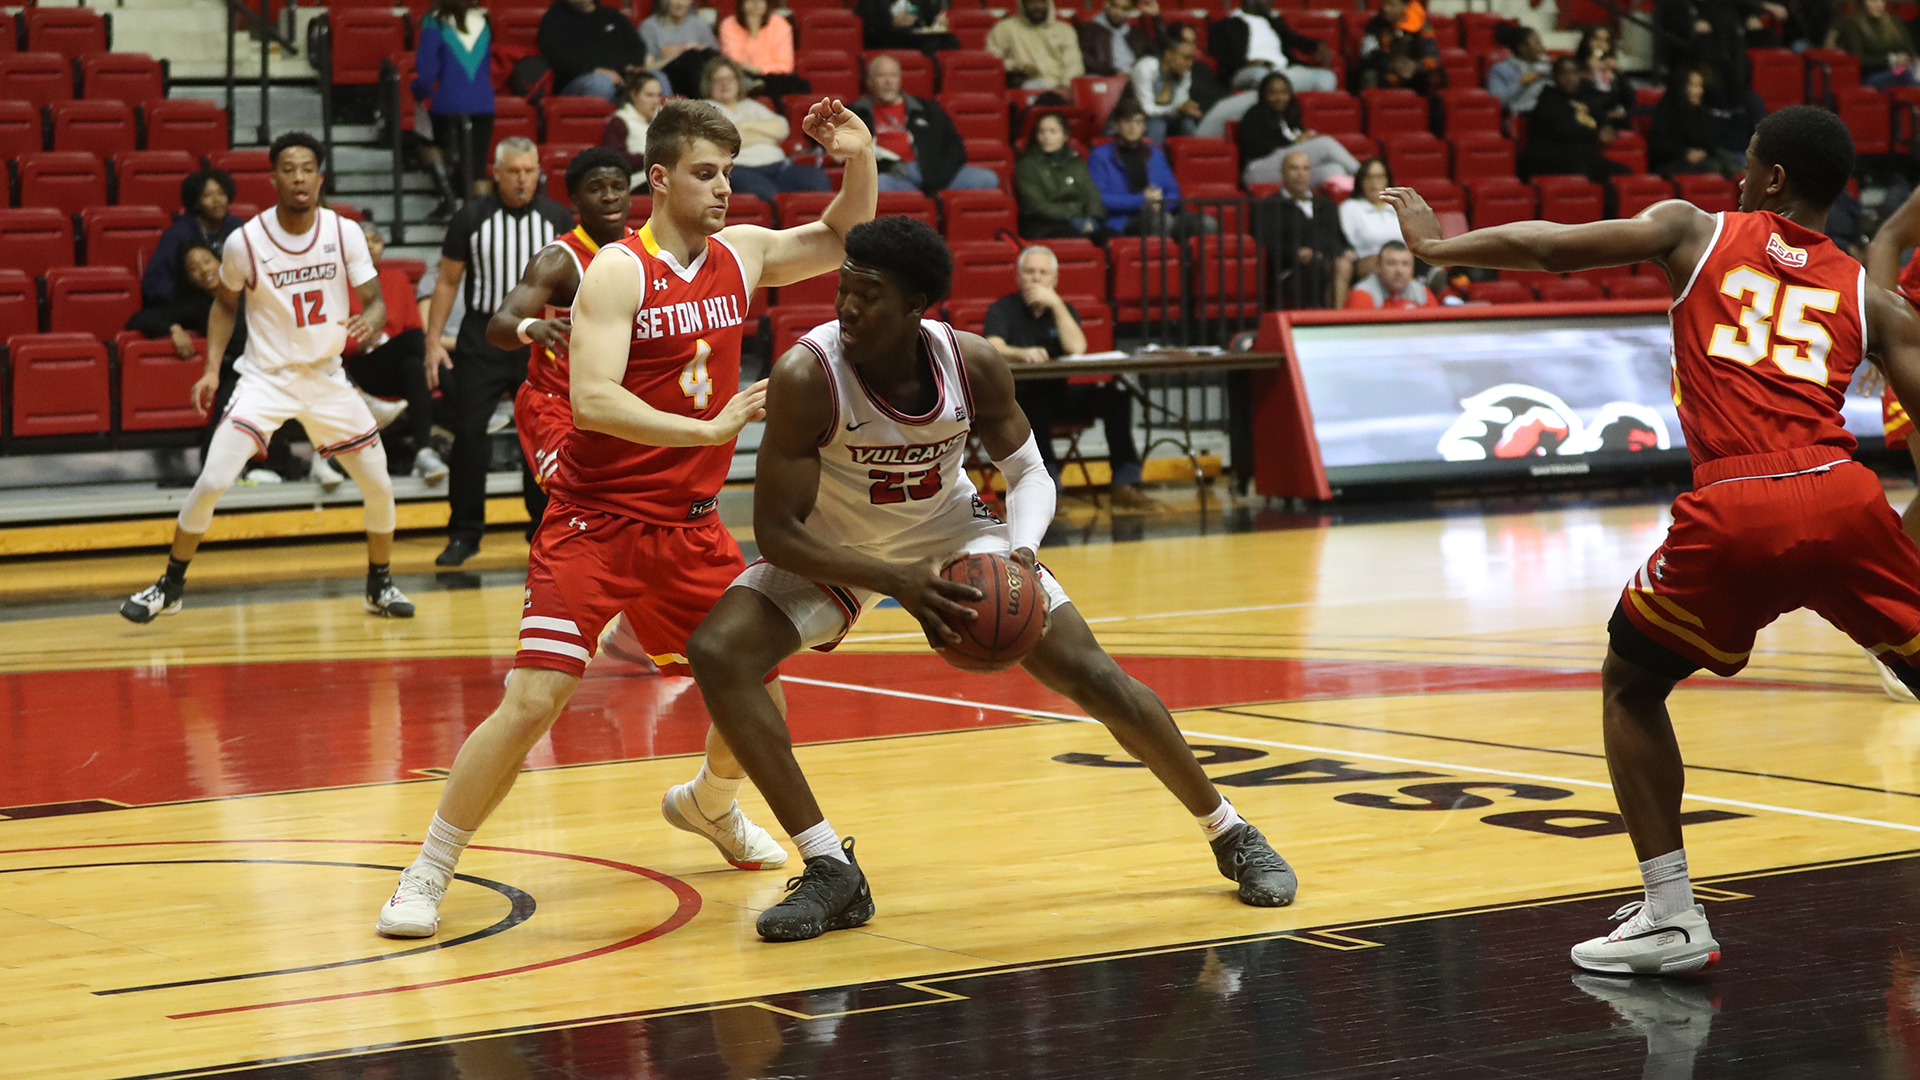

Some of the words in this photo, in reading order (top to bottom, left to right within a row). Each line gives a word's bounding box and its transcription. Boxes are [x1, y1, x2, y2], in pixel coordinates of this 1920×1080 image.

[1769, 239, 1805, 262] PSAC
[271, 263, 337, 289] VULCANS
[292, 290, 327, 328] 12
[636, 301, 703, 339] SETON
[702, 295, 742, 329] HILL
[1707, 265, 1840, 387] 35
[679, 339, 713, 410] 4
[853, 432, 967, 464] VULCANS
[869, 463, 942, 504] 23
[1051, 744, 1755, 839] PSAC
